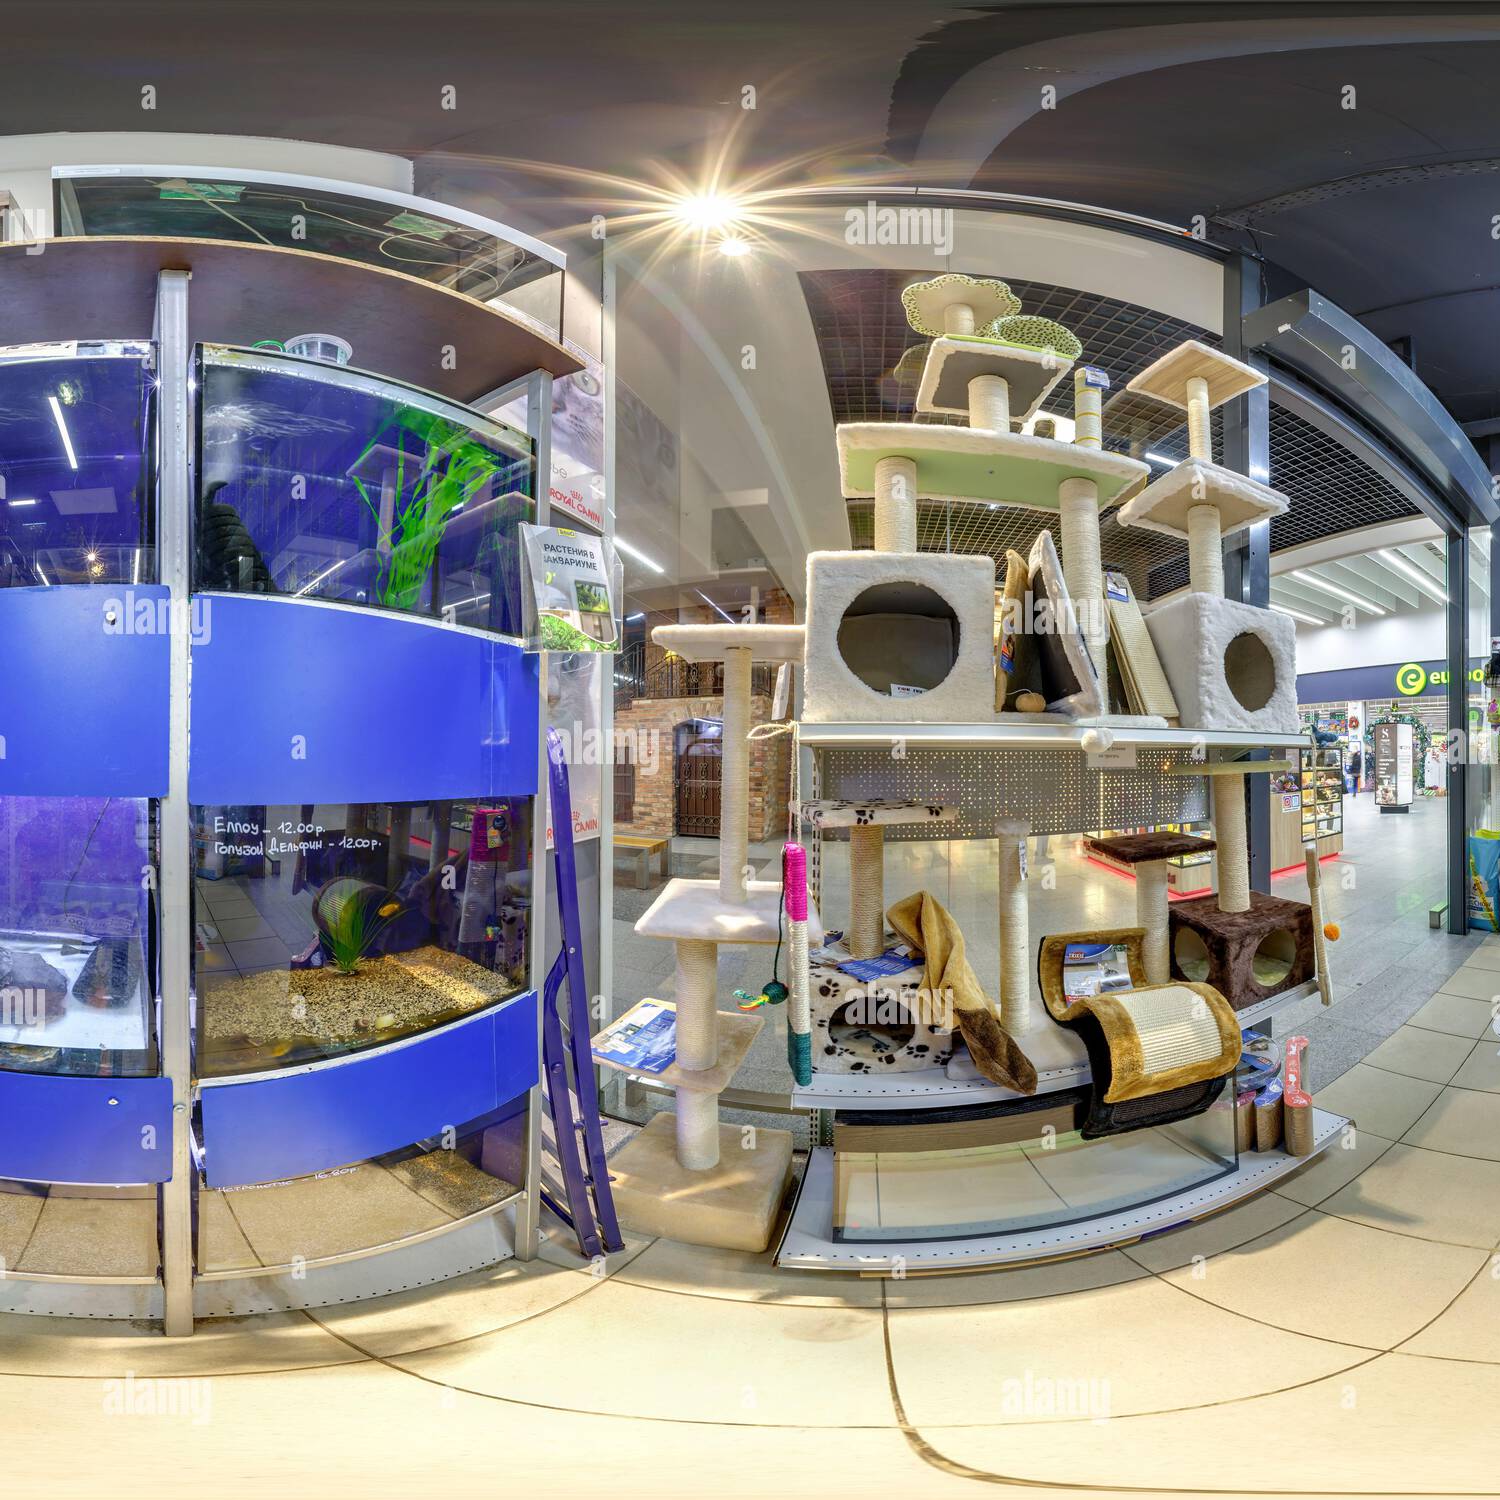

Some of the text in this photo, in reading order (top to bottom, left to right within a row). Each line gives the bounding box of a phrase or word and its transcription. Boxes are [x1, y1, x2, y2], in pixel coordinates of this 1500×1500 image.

[549, 488, 601, 524] ROYAL CANIN
[544, 543, 594, 560] РАСТЕНИЯ В
[545, 555, 598, 571] АКВАРИУМЕ
[574, 818, 598, 833] CANIN
